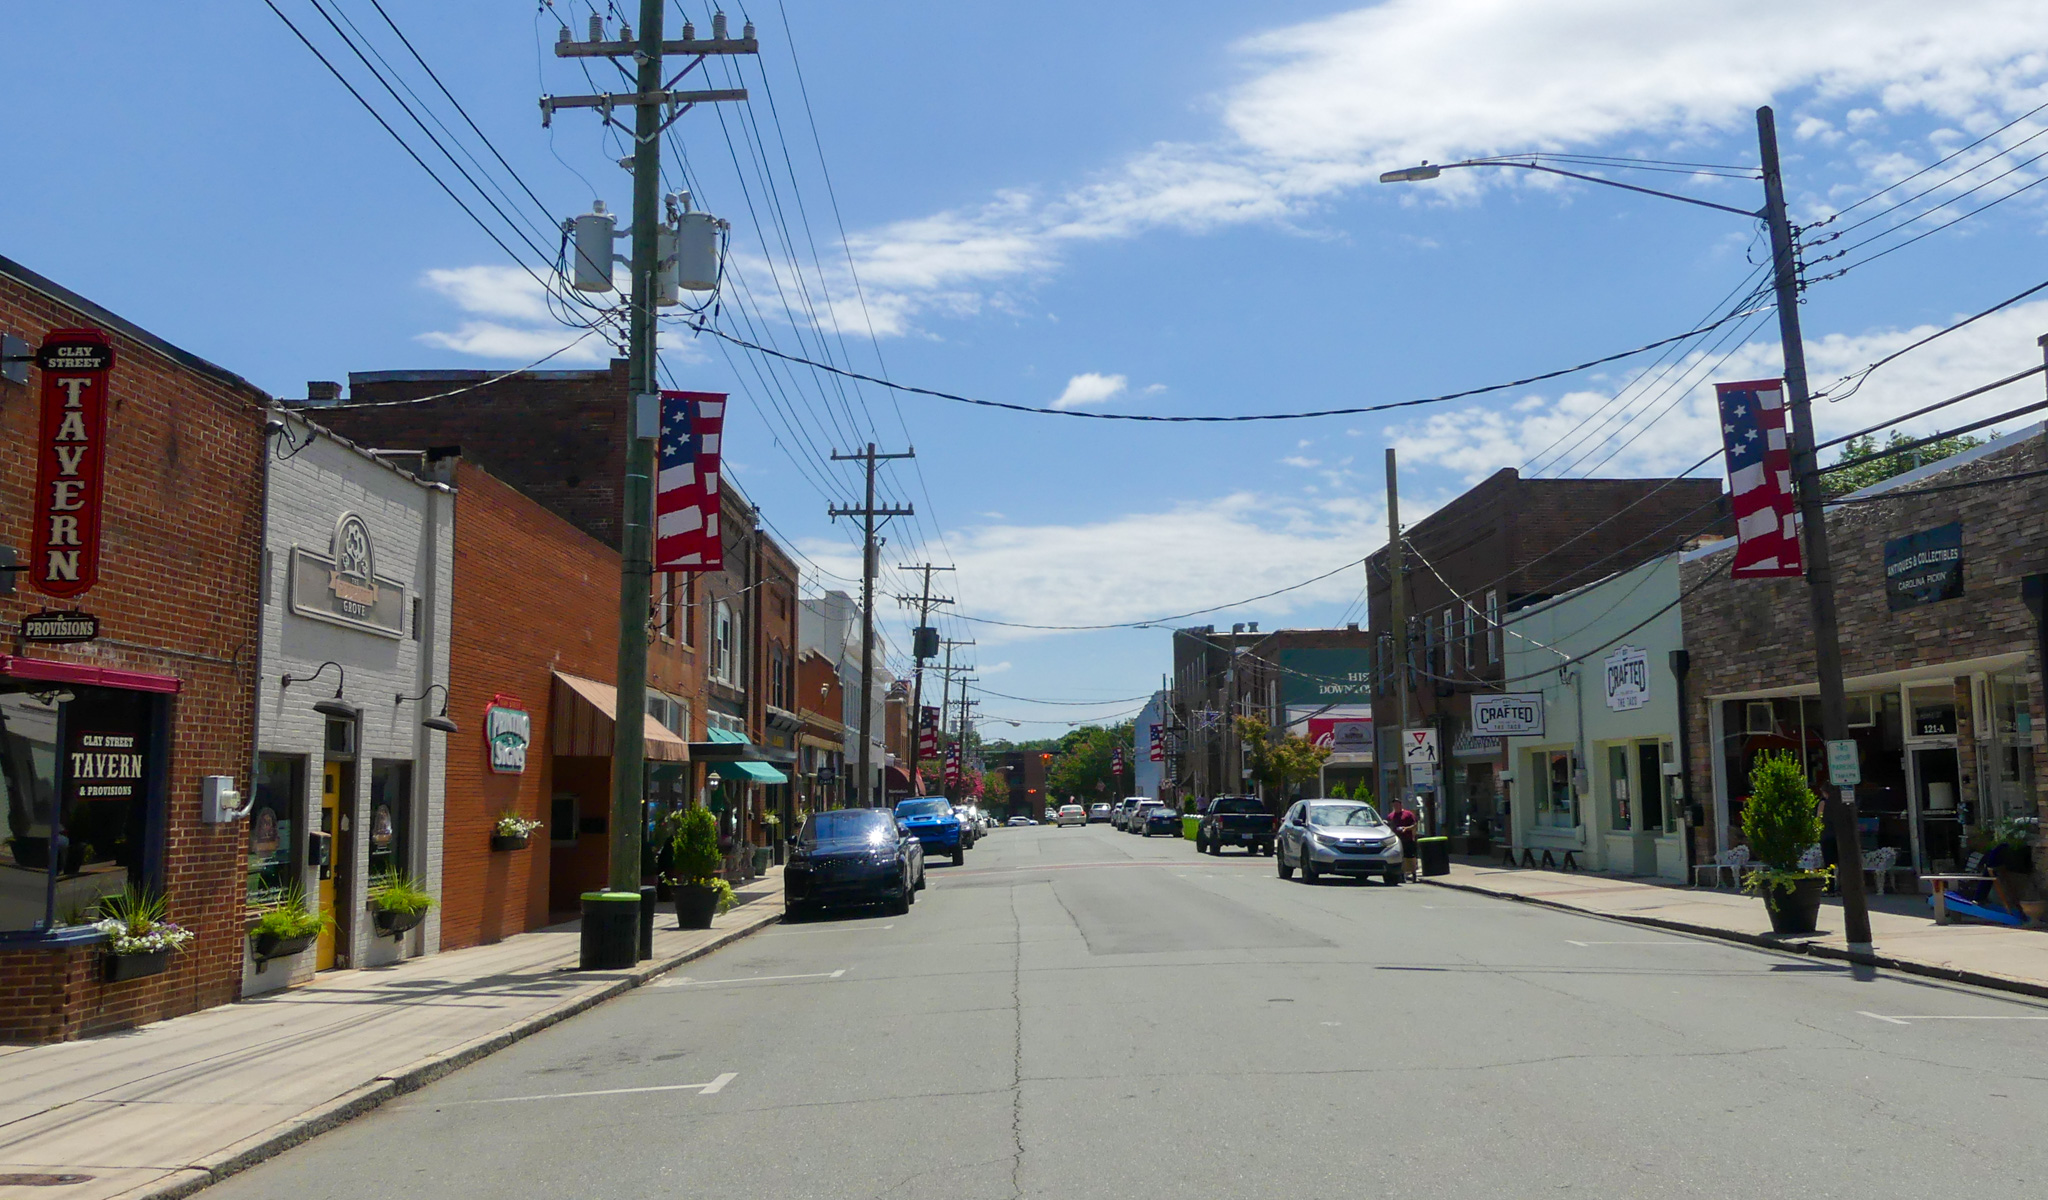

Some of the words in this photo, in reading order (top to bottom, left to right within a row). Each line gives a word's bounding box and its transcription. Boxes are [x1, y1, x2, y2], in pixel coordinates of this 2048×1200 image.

[58, 347, 93, 357] CLAY
[48, 358, 101, 368] STREET
[46, 377, 92, 581] TAVERN
[1887, 557, 1912, 577] ANTIQUES
[1918, 548, 1959, 565] COLLECTIBLES
[1898, 577, 1926, 591] CAROLINA
[343, 600, 366, 617] GROVE
[57, 614, 65, 622] &
[26, 621, 94, 636] PROVISIONS
[1608, 659, 1646, 698] CRAFTED
[1480, 707, 1533, 724] CRAFTED
[1923, 723, 1946, 734] 121-A
[83, 735, 103, 747] CLAY
[105, 736, 134, 748] STREET
[71, 752, 143, 779] TAVERN
[79, 786, 86, 796] &
[87, 786, 132, 796] PROVISIONS
